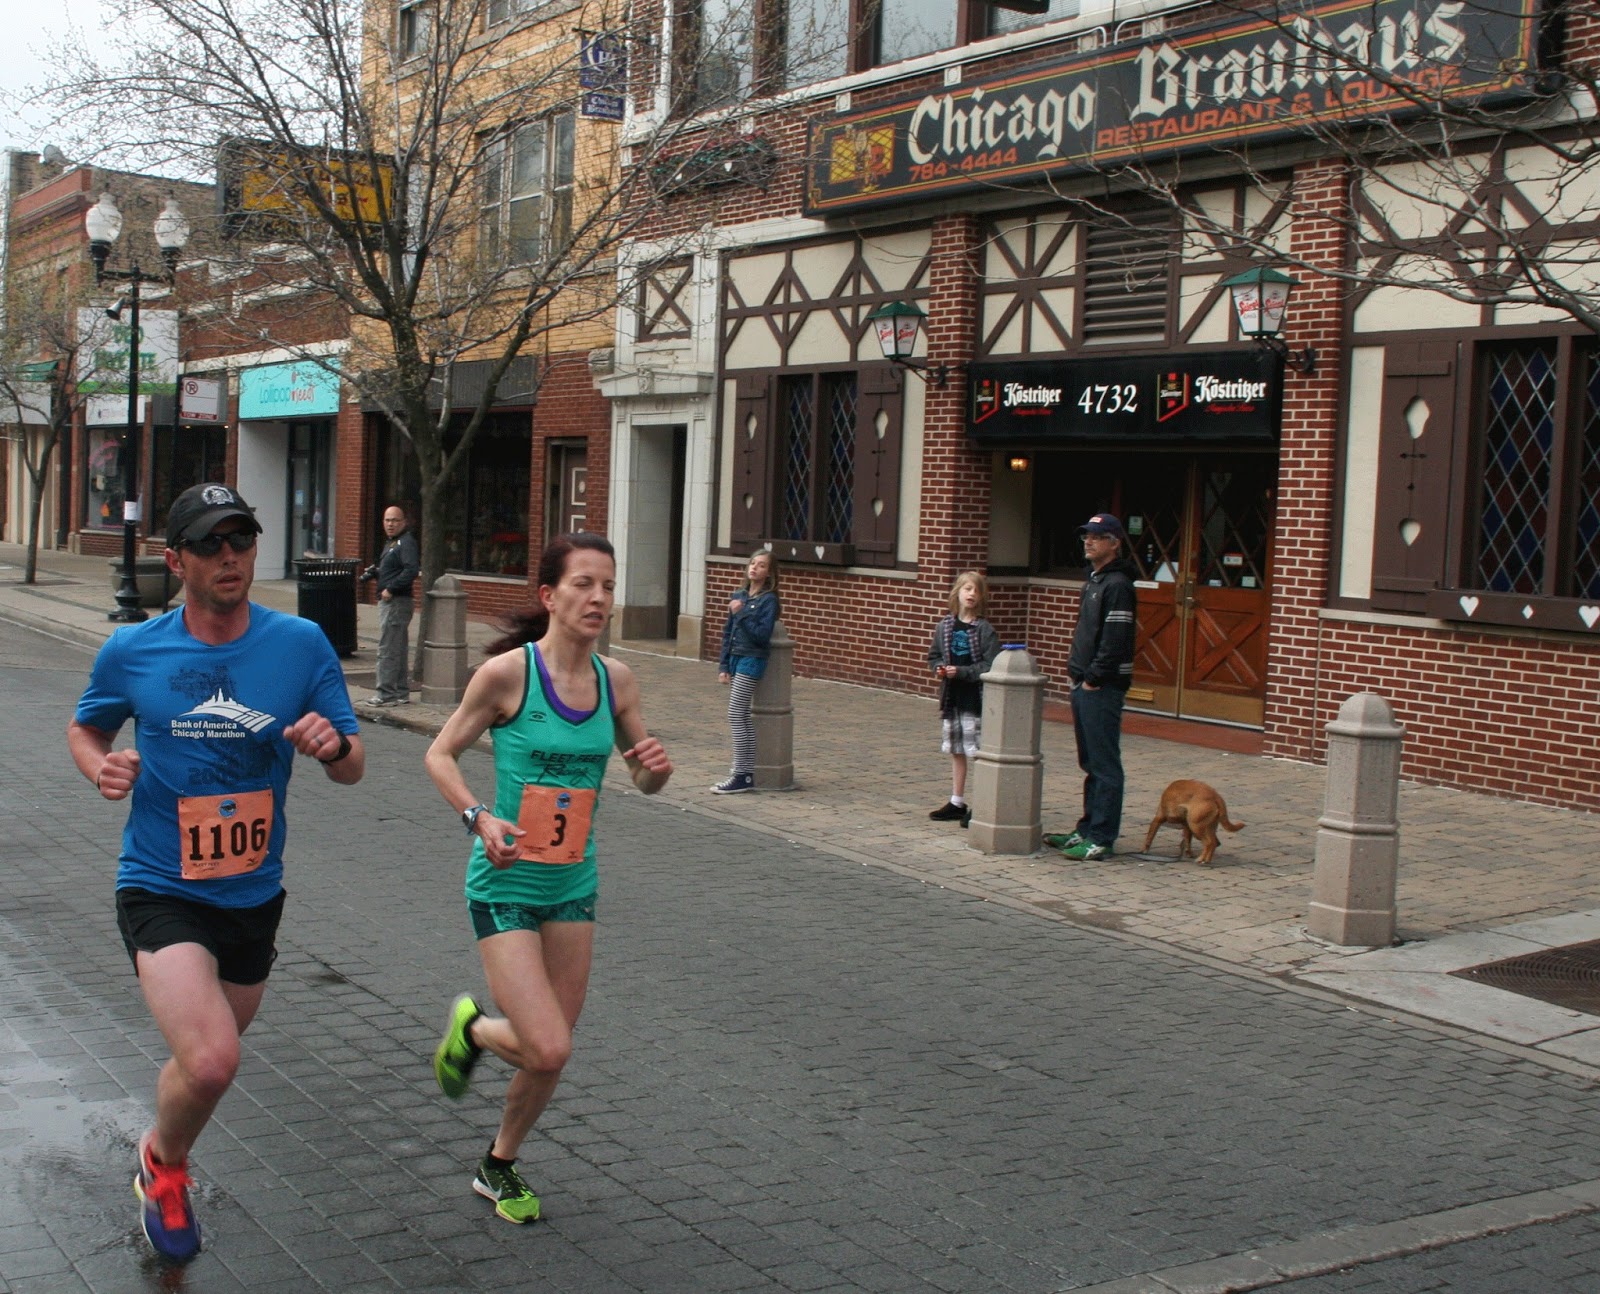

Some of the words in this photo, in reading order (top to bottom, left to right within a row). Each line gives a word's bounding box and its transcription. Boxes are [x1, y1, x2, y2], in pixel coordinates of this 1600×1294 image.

[907, 81, 1097, 165] Chicago
[1129, 2, 1466, 120] Brauhaus
[1096, 97, 1282, 149] RESTAURANT
[1290, 92, 1313, 114] &
[908, 147, 1018, 183] 784-4444
[1078, 384, 1139, 415] 4732
[171, 719, 192, 729] Bank
[193, 720, 203, 729] of
[203, 720, 237, 730] America
[172, 728, 205, 740] Chicago
[206, 729, 246, 739] Marathon
[530, 749, 576, 763] FLEET
[188, 817, 267, 862] 1106
[550, 813, 567, 848] 3
